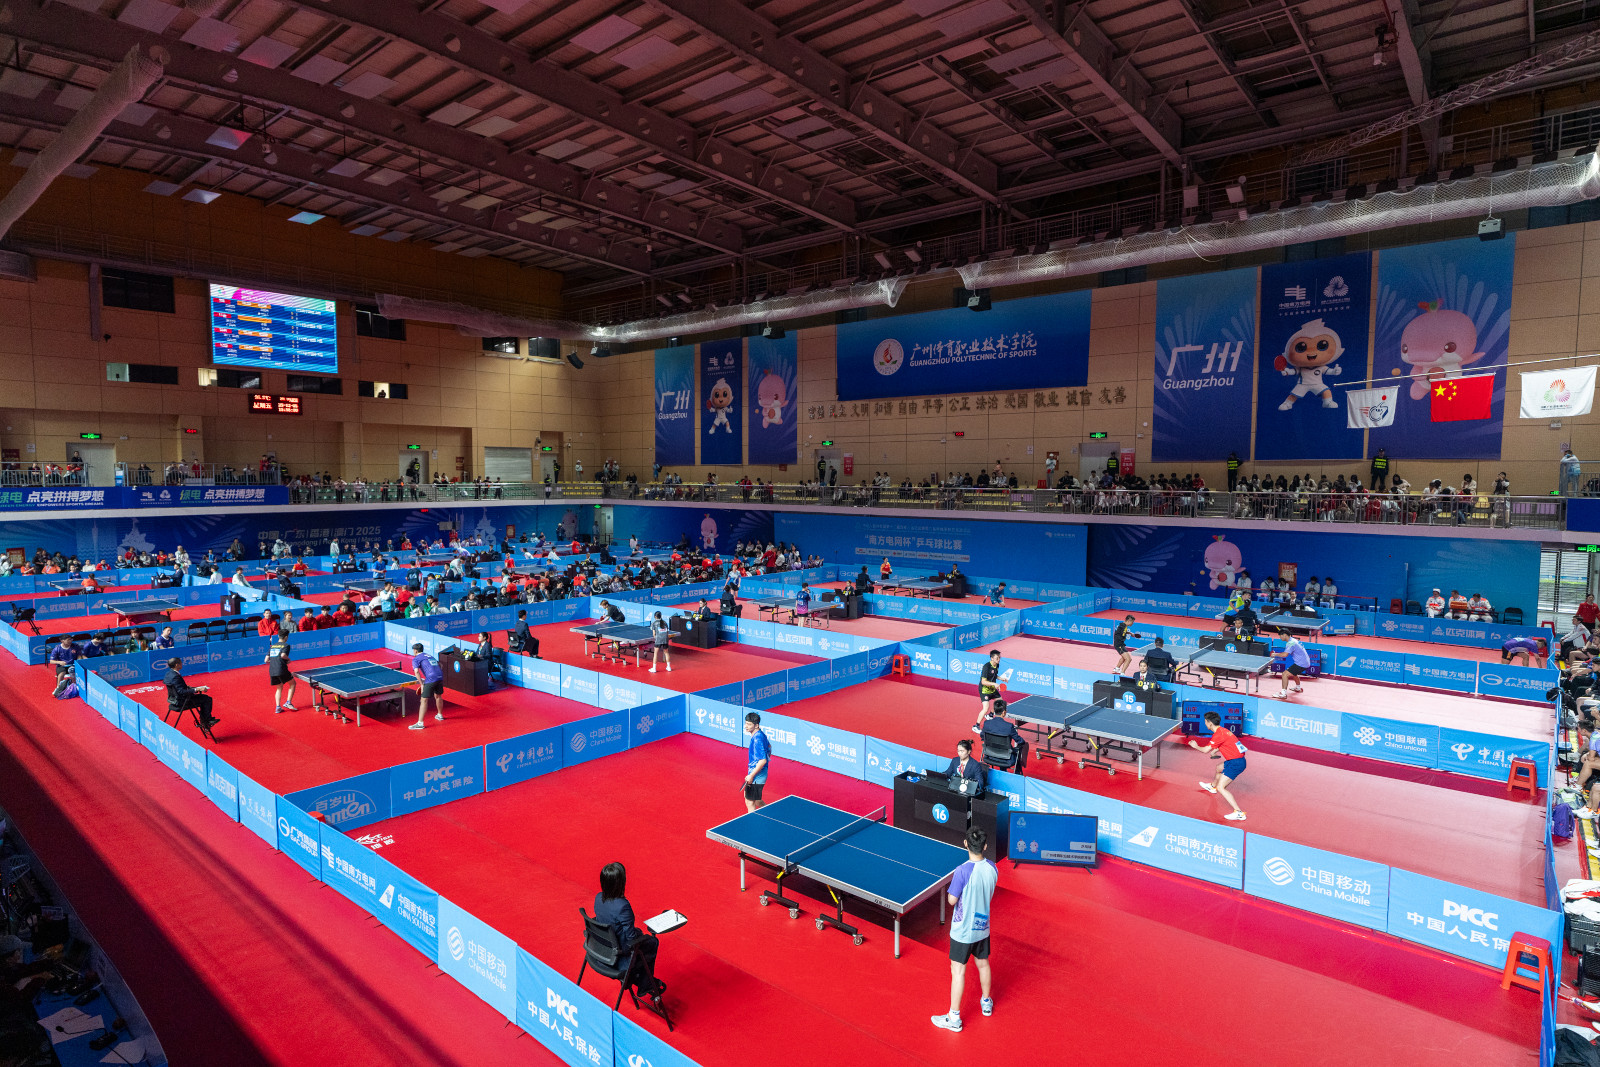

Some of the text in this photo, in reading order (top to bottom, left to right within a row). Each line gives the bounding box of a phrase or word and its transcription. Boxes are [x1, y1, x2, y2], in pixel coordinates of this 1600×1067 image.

[910, 331, 1038, 361] 广州体育职业技术学院
[909, 357, 950, 367] GUANGZHOU
[951, 353, 997, 363] POLYTECHNIC
[1009, 349, 1037, 357] SPORTS
[1166, 341, 1243, 377] 广州
[1163, 375, 1234, 391] Guangzhou
[660, 390, 690, 411] 广州
[851, 403, 869, 417] 文明
[873, 401, 893, 416] 和谐
[899, 400, 917, 415] 自由
[922, 399, 944, 414] 平等
[949, 397, 970, 411] 公正
[976, 394, 999, 410] 法治
[1034, 391, 1059, 408] 敬业
[1066, 389, 1092, 407] 诚信
[1099, 385, 1127, 404] 友善
[658, 411, 688, 420] Guangzhou
[26, 490, 105, 503] 点亮拼搏梦想
[203, 488, 266, 500] 点亮拼搏梦想
[356, 526, 381, 536] 2025
[1080, 625, 1112, 637] 匹克体育
[1446, 628, 1486, 640] 匹克体育
[911, 660, 942, 671] 国人民保险
[915, 652, 932, 662] PICC
[1360, 658, 1401, 668] 中国南方航空
[1016, 671, 1052, 683] 中国南方航空
[1422, 667, 1475, 680] 中国南方电网
[1505, 677, 1555, 688] 广汽集团
[756, 681, 786, 699] 匹克体育
[1124, 694, 1134, 703] 15
[708, 711, 736, 728] 中国电信
[1189, 723, 1236, 733] 1 0
[1280, 715, 1339, 738] 匹克体育
[590, 724, 622, 740] 中国移动
[590, 734, 622, 747] China Mobile
[1385, 732, 1427, 747] 中国联通
[516, 743, 554, 763] 中国电信
[827, 742, 857, 758] 中国联通
[1384, 741, 1427, 753] China unicom
[1478, 759, 1500, 767] CHINA
[423, 764, 454, 784] PICC
[403, 775, 474, 802] 中国人民保险
[315, 792, 356, 812] 百岁山
[325, 801, 371, 823] anten
[934, 808, 947, 820] 16
[290, 834, 319, 858] GAC GROUP
[291, 826, 318, 851] 广汽集团
[1165, 832, 1238, 860] 中国南方航空
[1165, 843, 1237, 868] CHINA SOUTHERN
[335, 856, 376, 891] 中国南方电网
[1302, 866, 1371, 896] 中国移动
[1301, 881, 1371, 907] China Mobile
[398, 893, 436, 929] 中国南方航空
[1443, 899, 1499, 931] PICC
[397, 906, 436, 938] CHINA SOUTHERN
[1406, 911, 1511, 953] 中国人民保
[468, 939, 507, 979] 中国移动
[468, 957, 507, 992] China Mobile
[546, 987, 579, 1028] PICC
[527, 1000, 601, 1066] 中国人民保险
